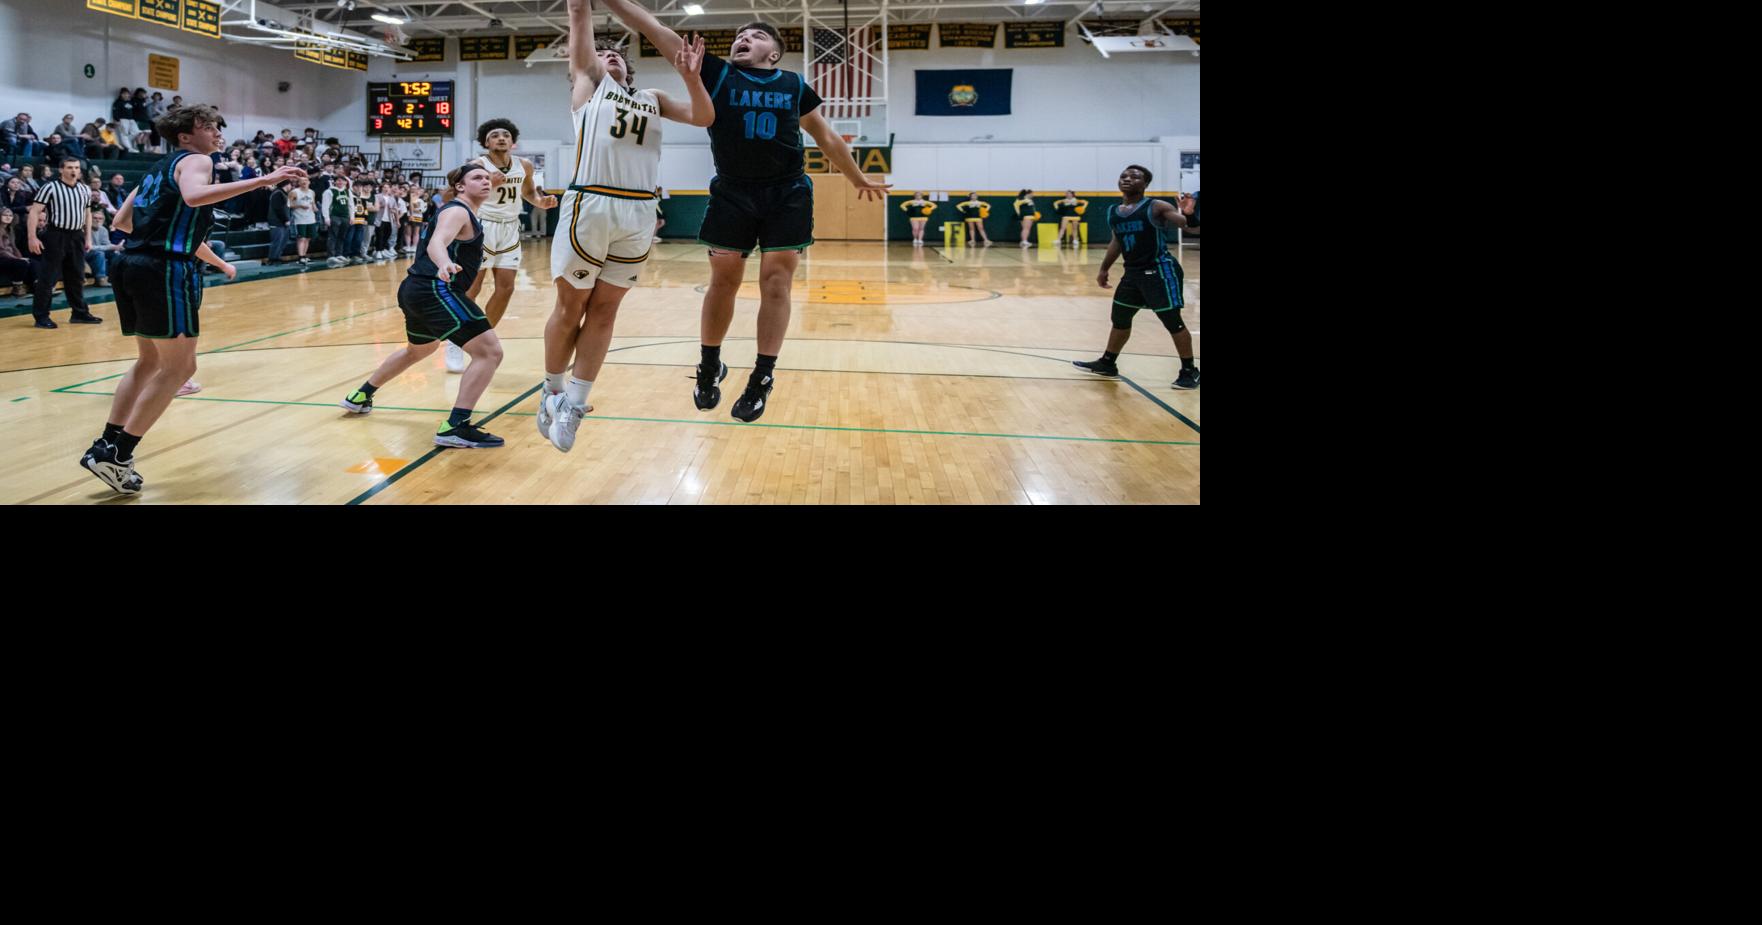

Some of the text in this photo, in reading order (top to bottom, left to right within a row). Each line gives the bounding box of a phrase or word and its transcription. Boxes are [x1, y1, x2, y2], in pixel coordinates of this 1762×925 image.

[400, 82, 431, 95] 7:52
[729, 88, 793, 110] LAKERS
[380, 102, 393, 115] 12
[405, 103, 415, 114] 2
[436, 102, 449, 114] 18
[374, 119, 383, 129] 3
[396, 118, 412, 129] 42
[418, 119, 423, 128] 1
[441, 119, 449, 128] 4
[610, 107, 648, 145] 34
[743, 110, 777, 139] 10
[804, 149, 889, 172] BA
[496, 186, 516, 204] 24
[951, 223, 962, 244] F
